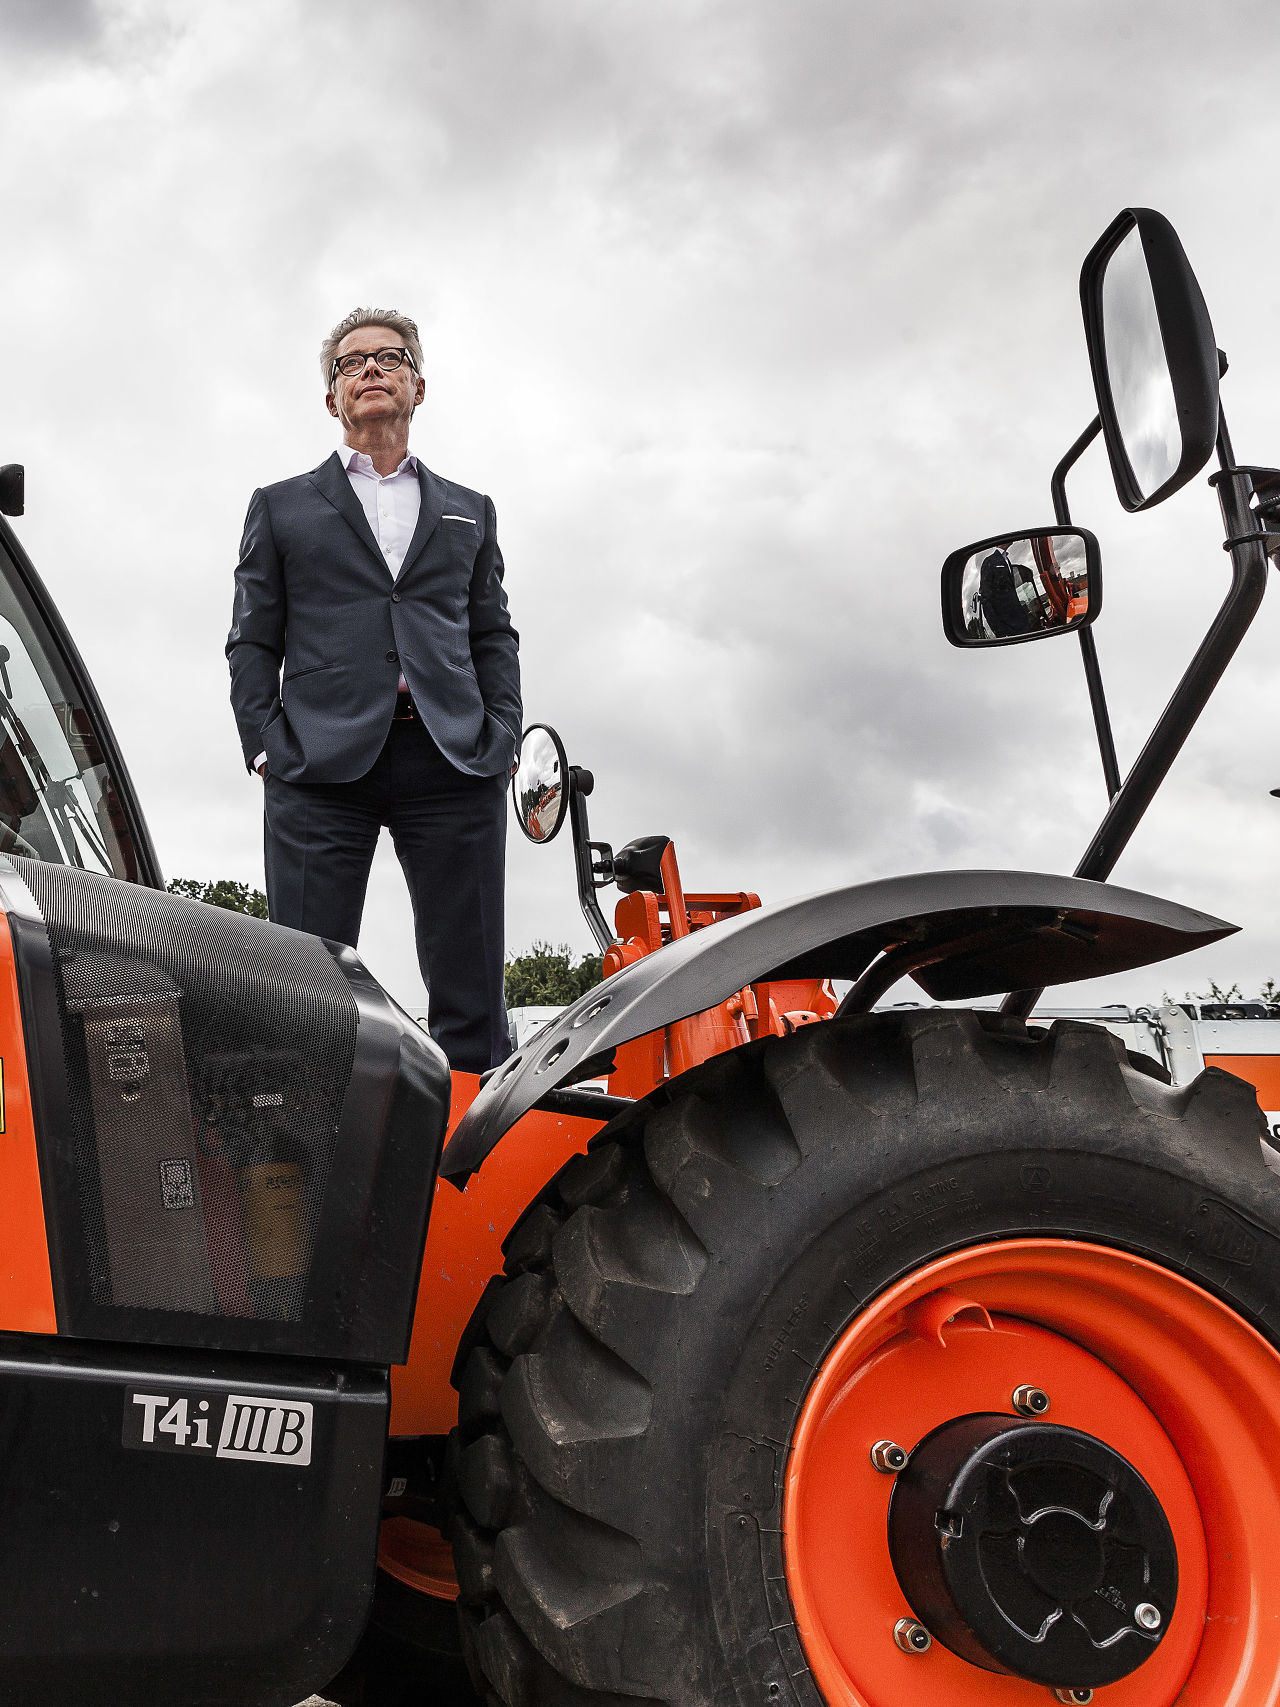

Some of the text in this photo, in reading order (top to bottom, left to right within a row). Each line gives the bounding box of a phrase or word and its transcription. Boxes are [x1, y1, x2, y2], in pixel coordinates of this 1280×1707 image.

[762, 1297, 809, 1369] TUBELESS
[132, 1393, 306, 1457] T4i IIIB
